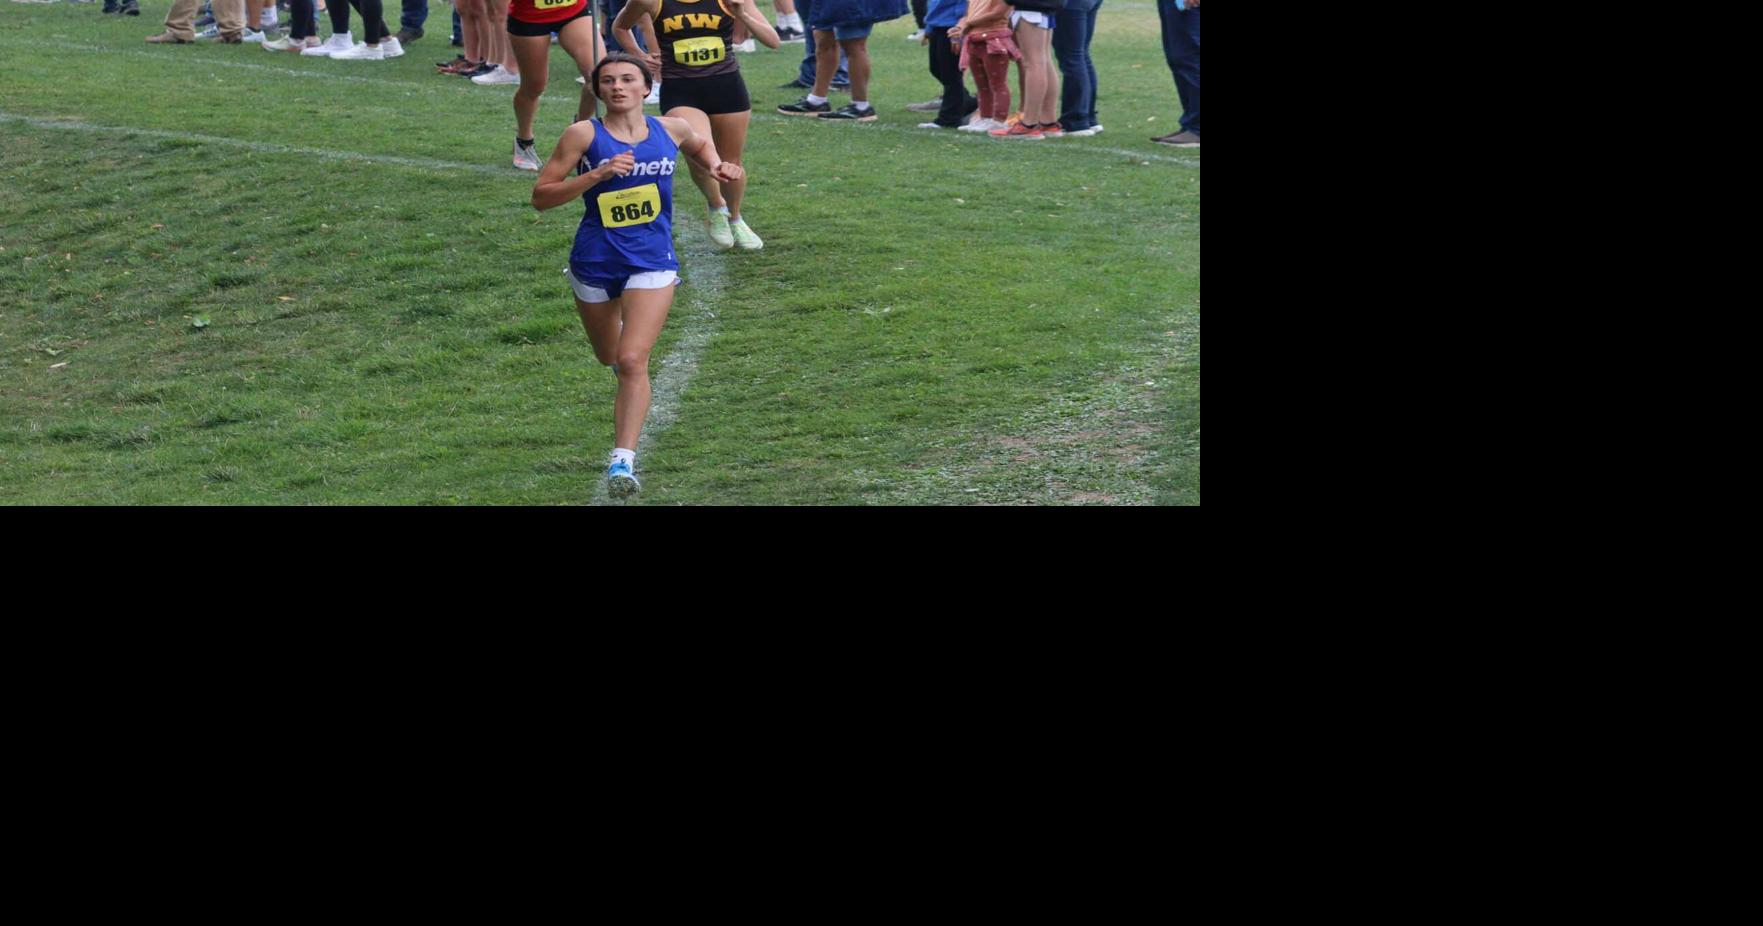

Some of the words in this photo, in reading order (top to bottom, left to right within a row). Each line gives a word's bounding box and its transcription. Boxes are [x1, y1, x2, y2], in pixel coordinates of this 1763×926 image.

[663, 13, 722, 33] NW
[683, 48, 718, 63] 1131
[598, 157, 675, 176] mets
[611, 200, 654, 222] 864
